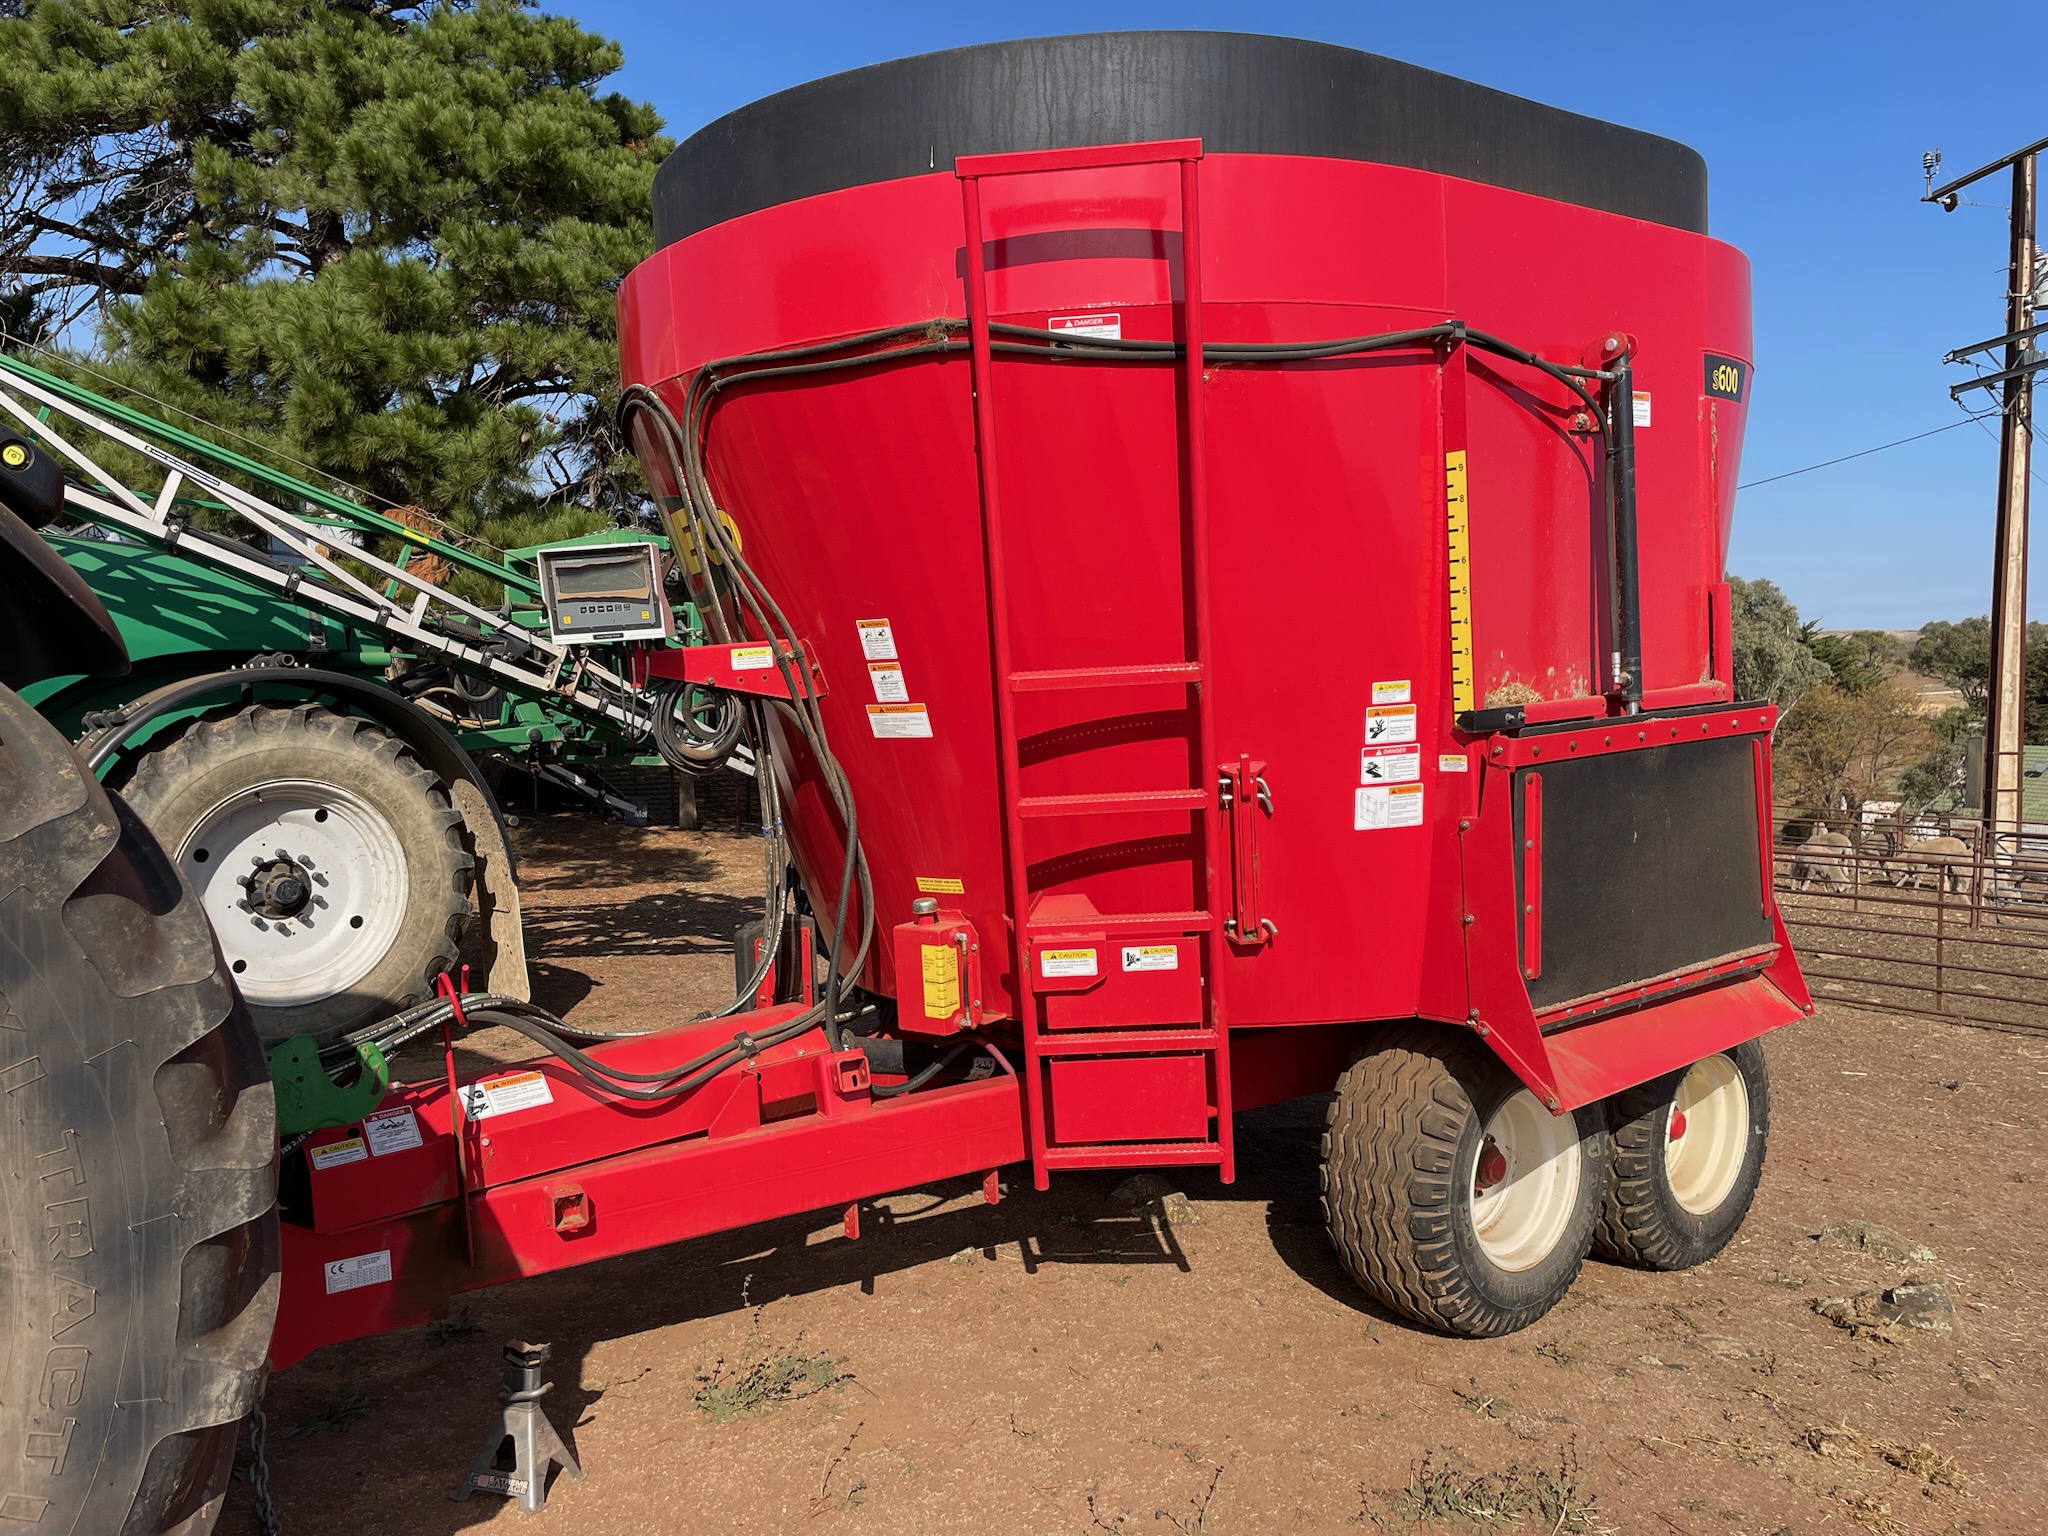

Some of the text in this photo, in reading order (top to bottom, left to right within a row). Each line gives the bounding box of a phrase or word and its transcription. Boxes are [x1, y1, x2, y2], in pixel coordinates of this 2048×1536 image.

[1074, 318, 1103, 326] DANGER
[1458, 463, 1464, 471] 9
[1459, 494, 1465, 503] 8
[1460, 525, 1465, 533] 7
[1461, 556, 1466, 564] 6
[1462, 586, 1467, 595] 5
[1463, 617, 1468, 625] 4
[1464, 647, 1470, 656] 3
[1465, 678, 1471, 686] 2
[1381, 708, 1409, 716] WARNING
[1383, 747, 1407, 755] DANGER
[500, 1074, 534, 1086] WARNING
[378, 1109, 405, 1119] DANGER
[328, 1141, 357, 1152] CAUTION
[489, 1475, 529, 1488] EXTREME
[488, 1482, 527, 1495] GARAGE
